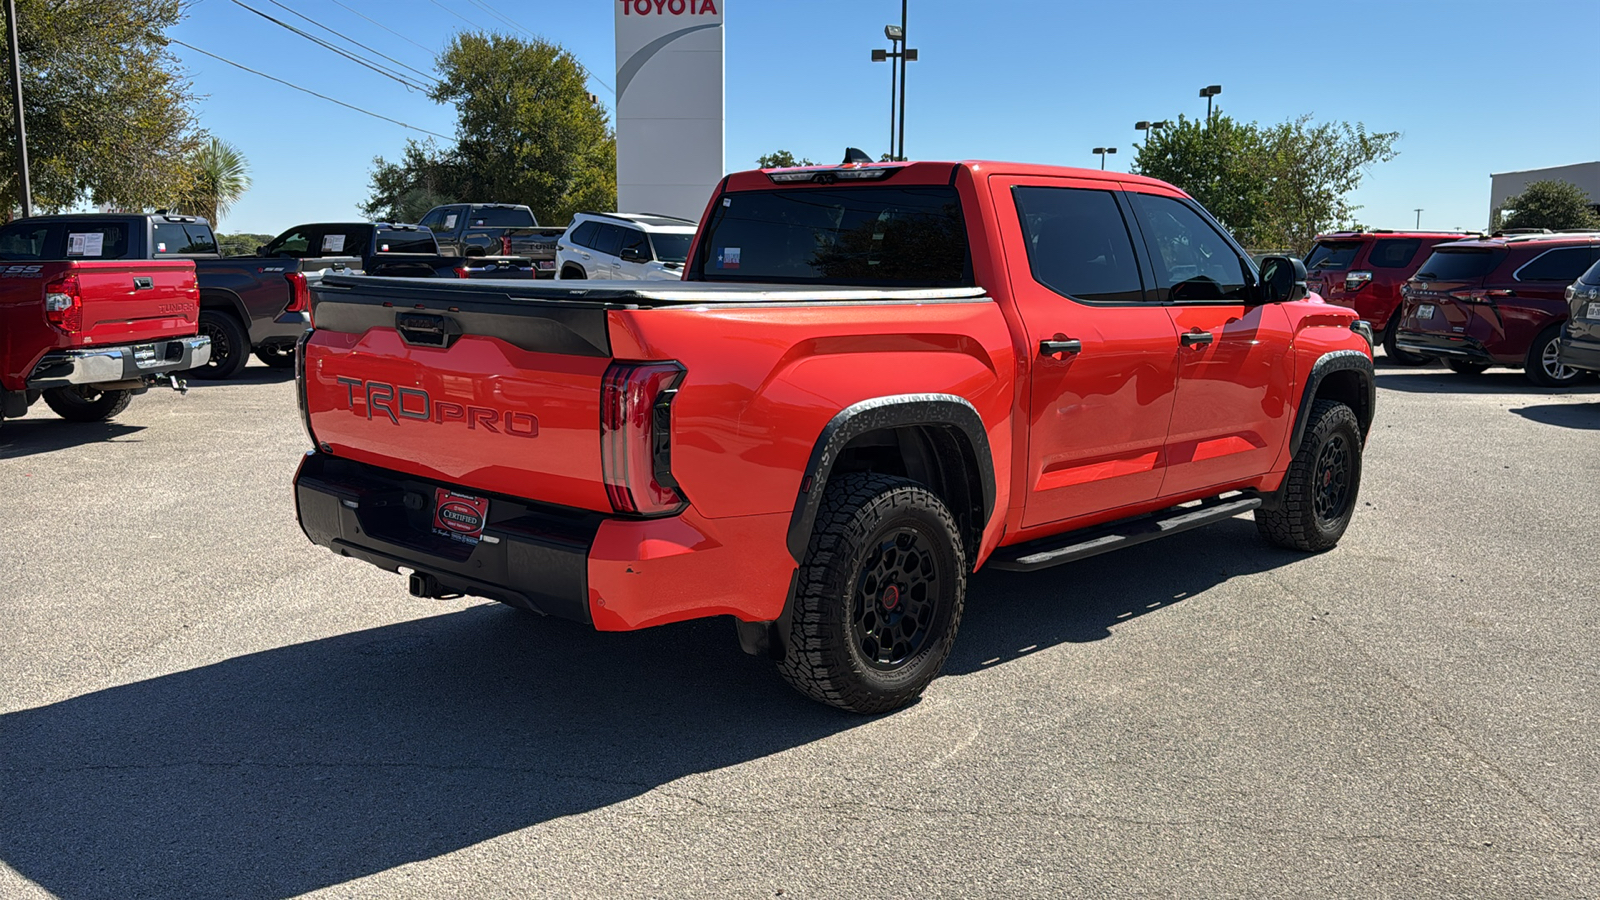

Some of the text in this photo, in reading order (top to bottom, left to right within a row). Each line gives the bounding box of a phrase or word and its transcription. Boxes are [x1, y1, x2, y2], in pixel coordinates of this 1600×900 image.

[619, 0, 717, 16] TOYOTA
[159, 303, 195, 314] TUNDRA
[336, 375, 540, 439] TRD PRO
[443, 510, 477, 524] CERTIFIED
